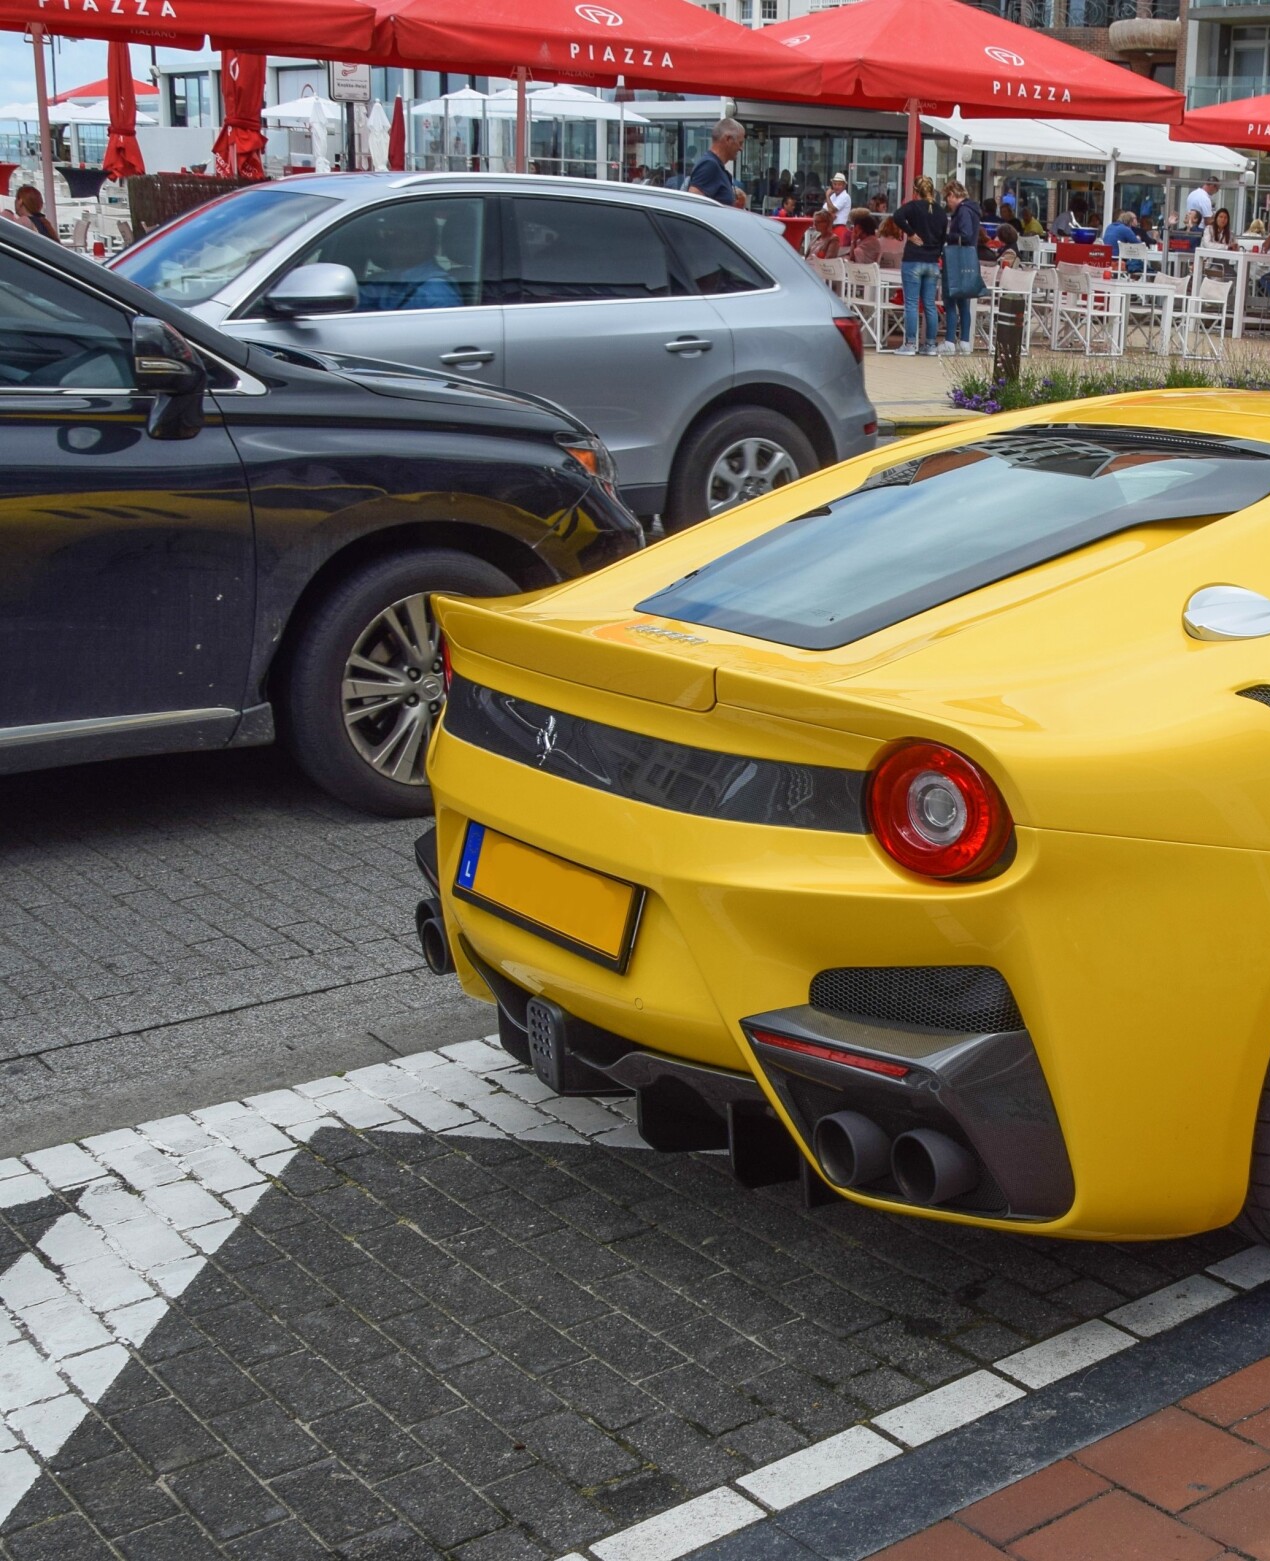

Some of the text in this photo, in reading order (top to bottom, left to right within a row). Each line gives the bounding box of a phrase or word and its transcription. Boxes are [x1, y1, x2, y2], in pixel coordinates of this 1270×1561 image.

[570, 42, 674, 69] PIAZZA
[993, 80, 1071, 103] PIAZZA
[465, 860, 471, 877] L
